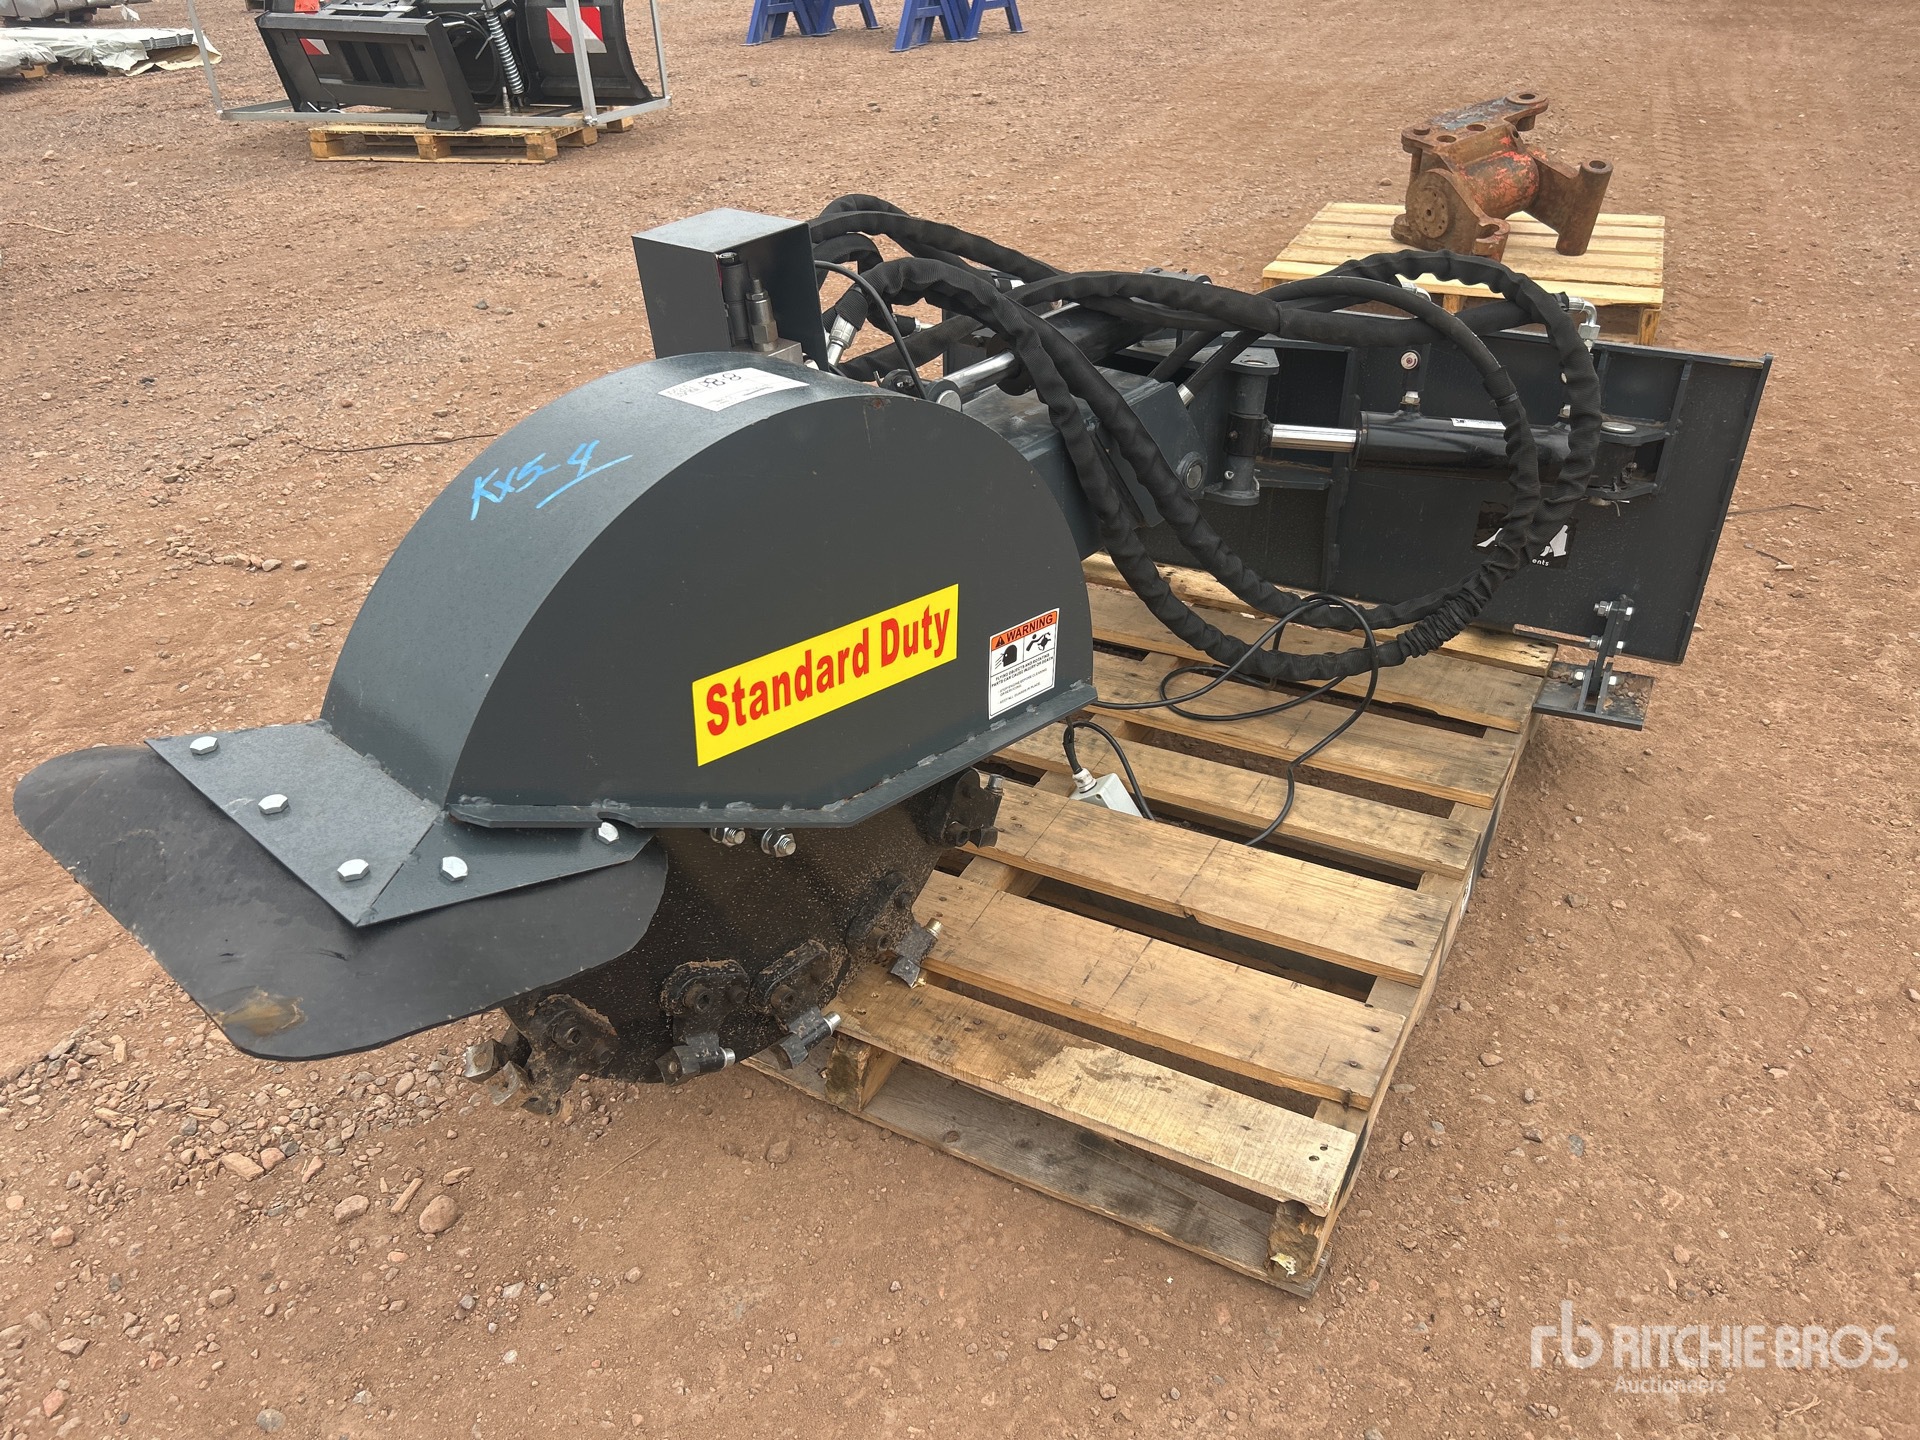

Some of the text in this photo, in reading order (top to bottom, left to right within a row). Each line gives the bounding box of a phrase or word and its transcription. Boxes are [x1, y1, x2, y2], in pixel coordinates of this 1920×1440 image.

[1006, 614, 1053, 642] WARNING
[705, 604, 951, 737] Standard Duty
